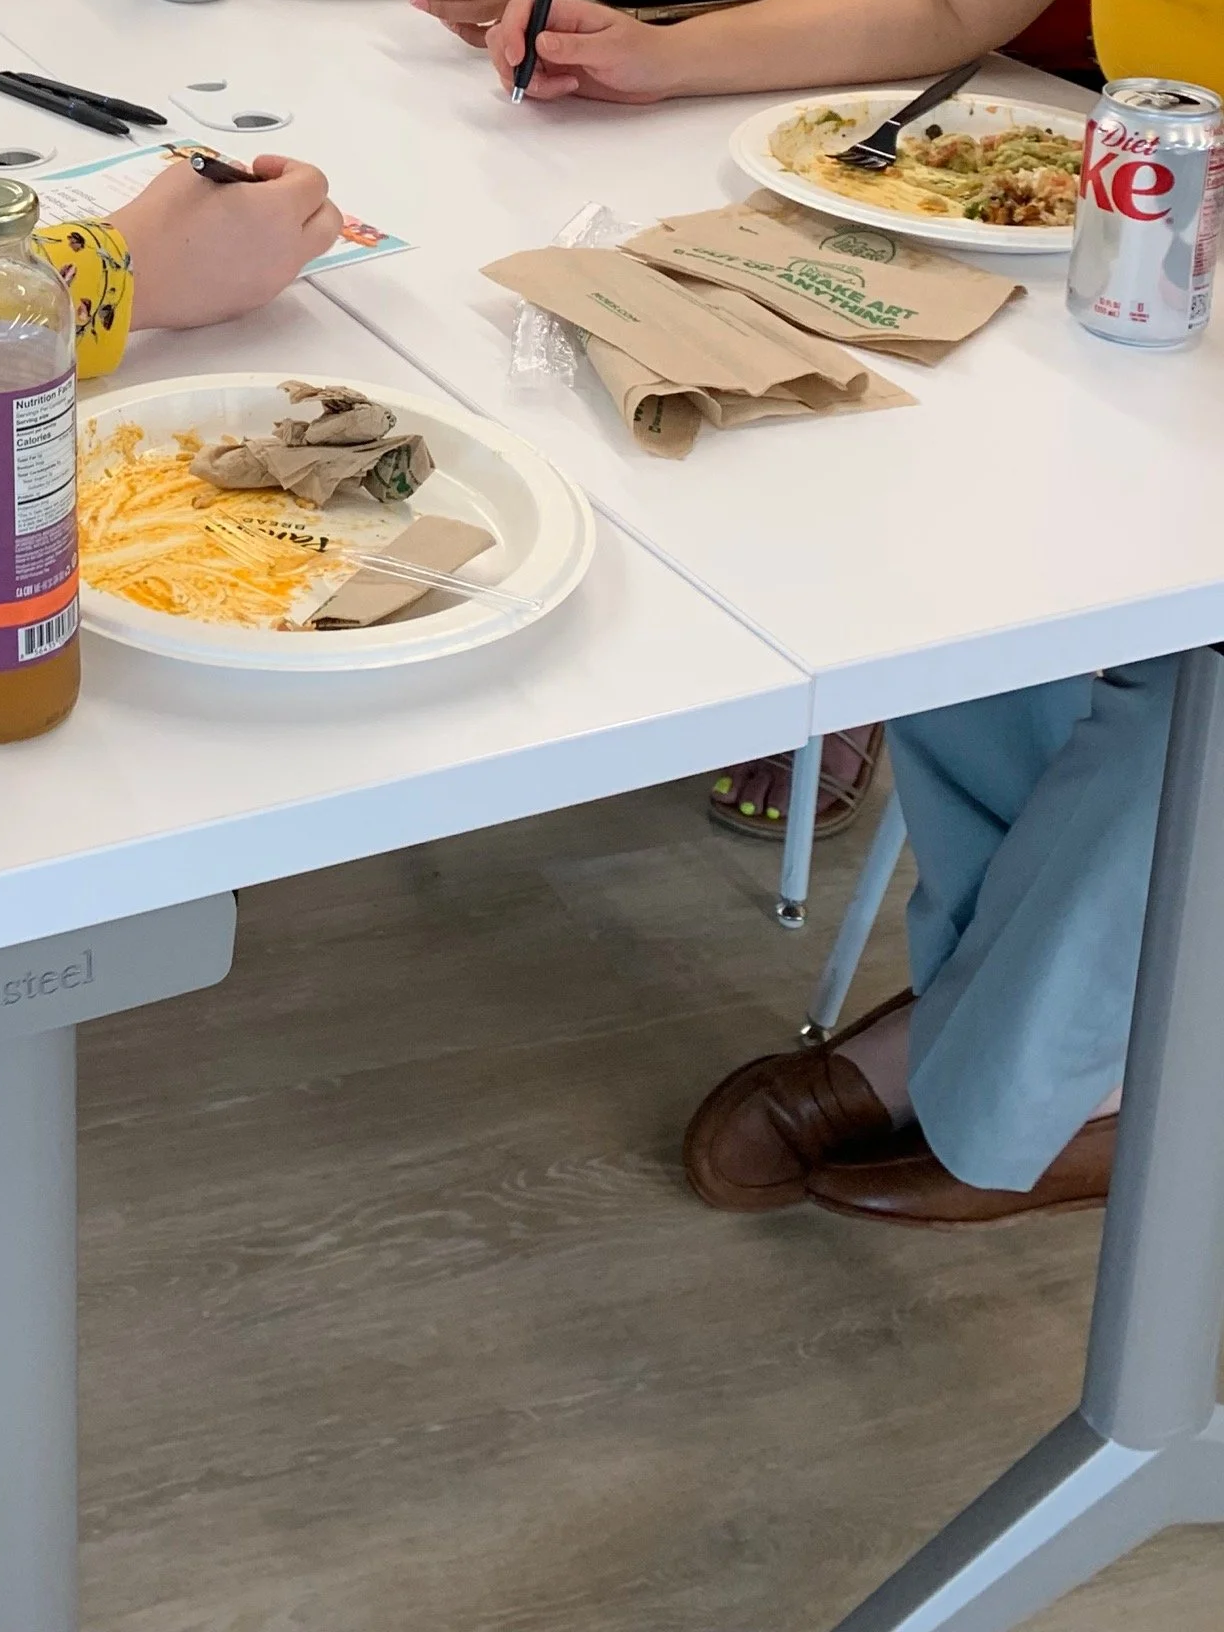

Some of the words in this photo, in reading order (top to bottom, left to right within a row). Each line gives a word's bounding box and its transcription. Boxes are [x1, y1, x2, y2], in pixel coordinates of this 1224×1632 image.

[1095, 119, 1161, 156] Diet
[776, 272, 900, 329] ANYTHING.
[867, 300, 920, 320] ART
[16, 391, 57, 409] Nutrition
[16, 432, 52, 447] Calories
[243, 518, 306, 531] BREAD
